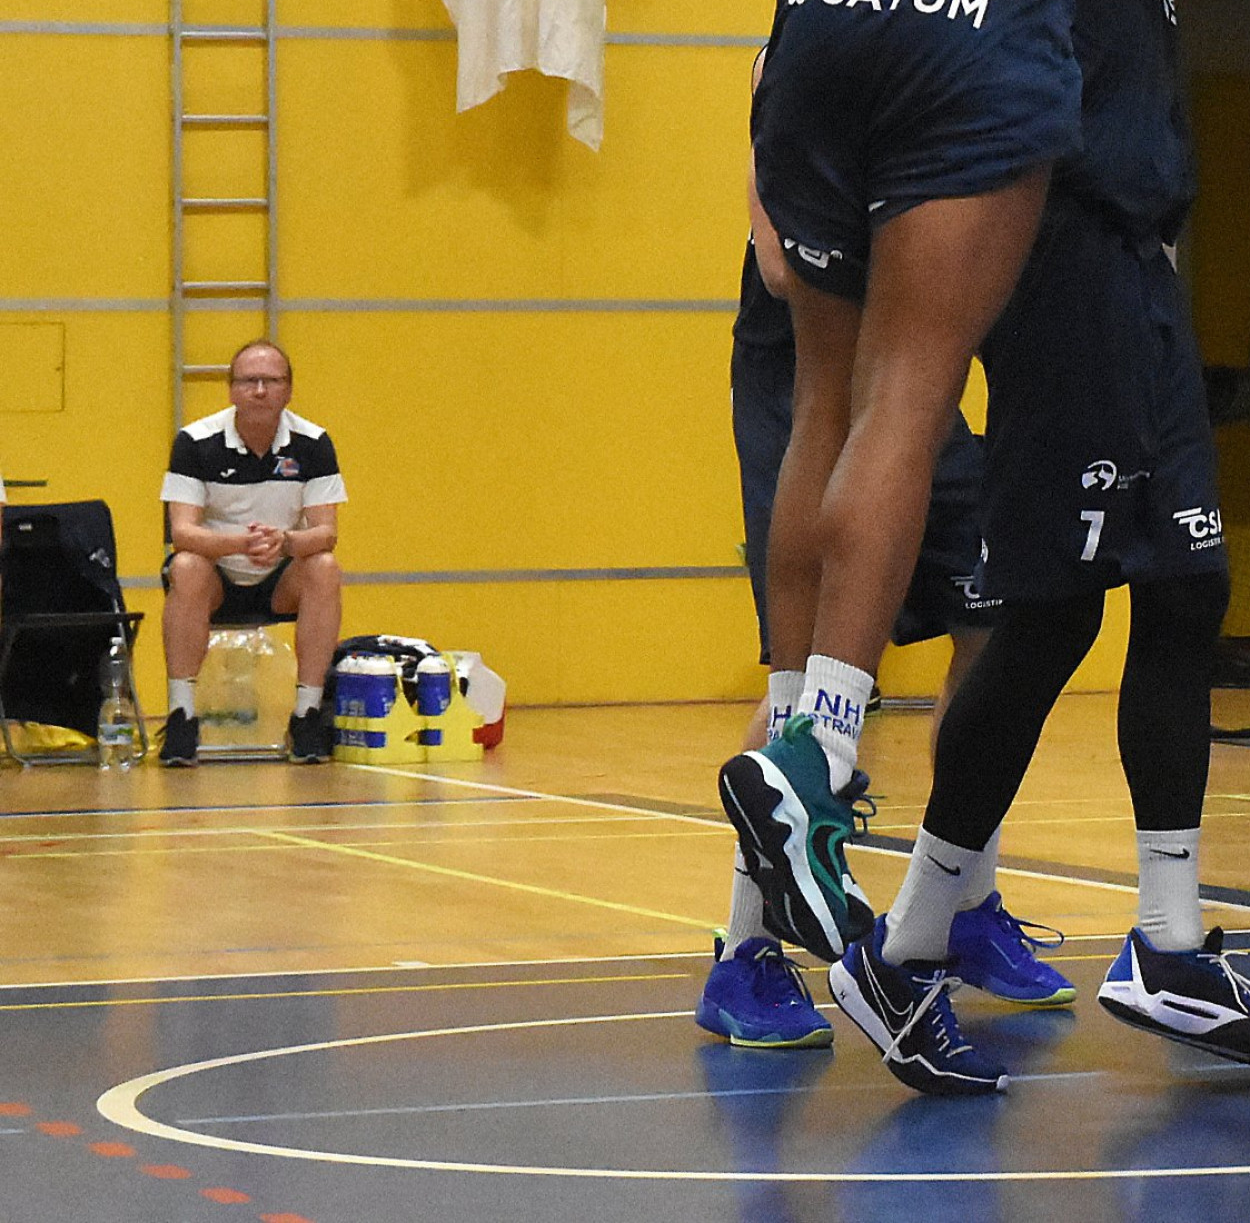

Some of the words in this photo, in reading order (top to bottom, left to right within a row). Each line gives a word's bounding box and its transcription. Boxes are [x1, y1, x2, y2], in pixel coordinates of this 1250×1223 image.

[1080, 510, 1105, 561] 7
[1190, 537, 1225, 551] LOGISTI
[814, 688, 861, 726] NH
